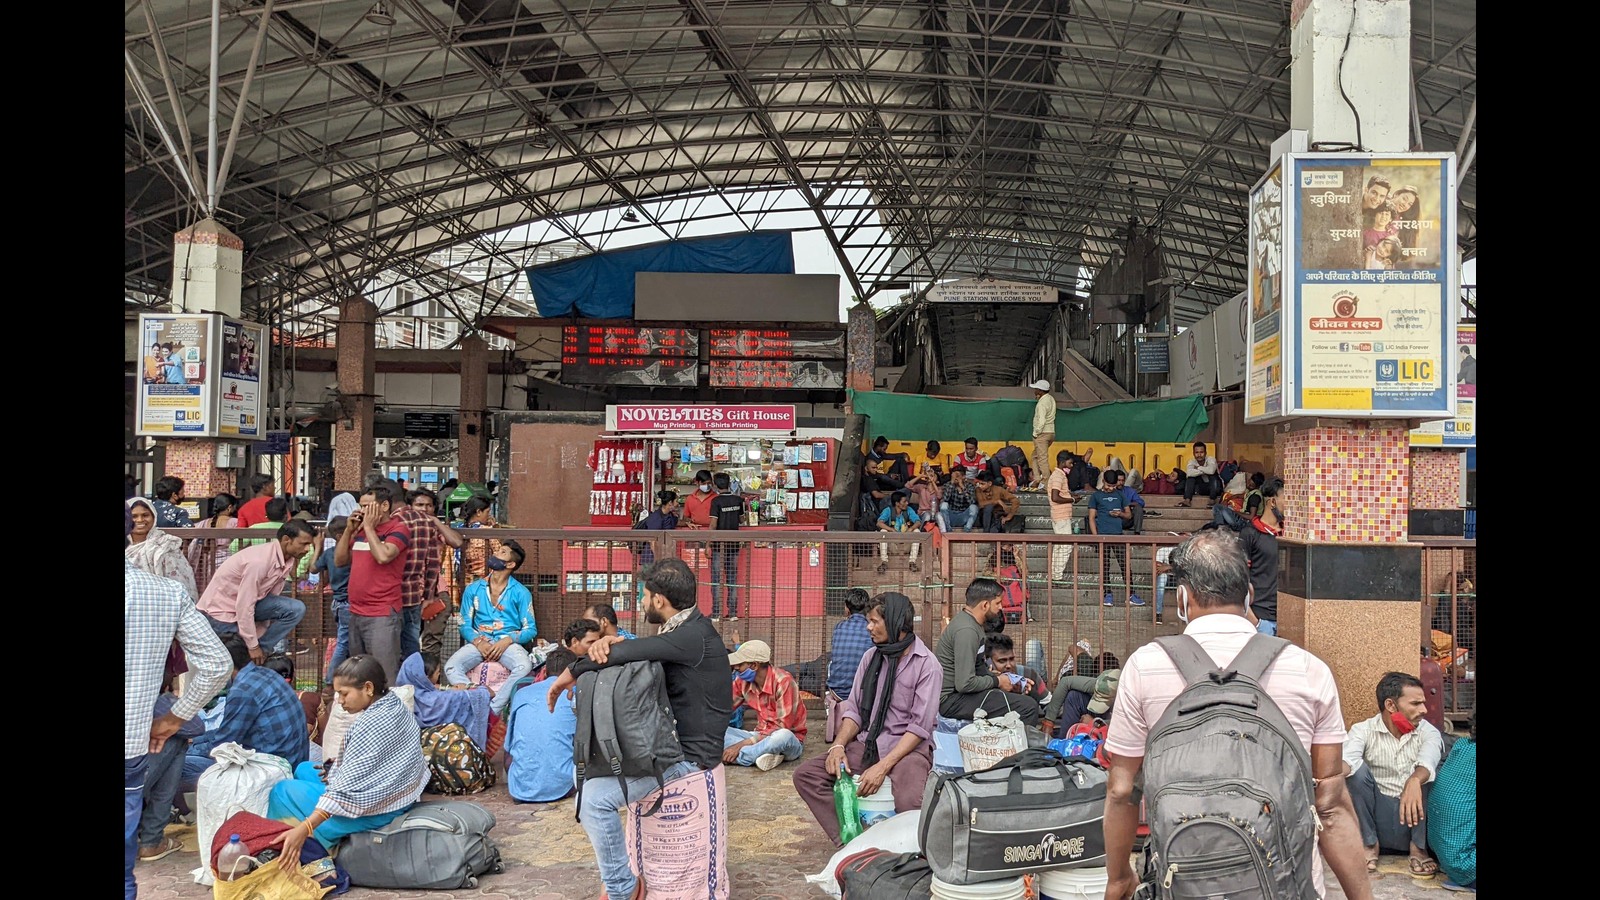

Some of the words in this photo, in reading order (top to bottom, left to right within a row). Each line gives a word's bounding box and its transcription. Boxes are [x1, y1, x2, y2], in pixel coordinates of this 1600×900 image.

[1391, 217, 1433, 230] संरक्षण
[1329, 228, 1361, 241] सुरक्षा
[1401, 247, 1427, 257] बचत
[1306, 271, 1323, 281] अपने
[1324, 271, 1350, 281] परिवार
[1351, 271, 1359, 280] के
[1360, 270, 1376, 282] लिए
[1411, 271, 1436, 281] कीजिए
[1311, 319, 1348, 328] जीवन
[1350, 320, 1380, 329] लक्ष्य
[1402, 362, 1430, 379] LIC
[187, 411, 200, 420] LIC
[620, 408, 724, 421] NOVELTIES
[727, 410, 750, 420] Gift
[753, 410, 790, 420] House
[1457, 423, 1470, 431] LIC
[657, 799, 694, 814] AMRAT
[677, 834, 698, 842] PACKS
